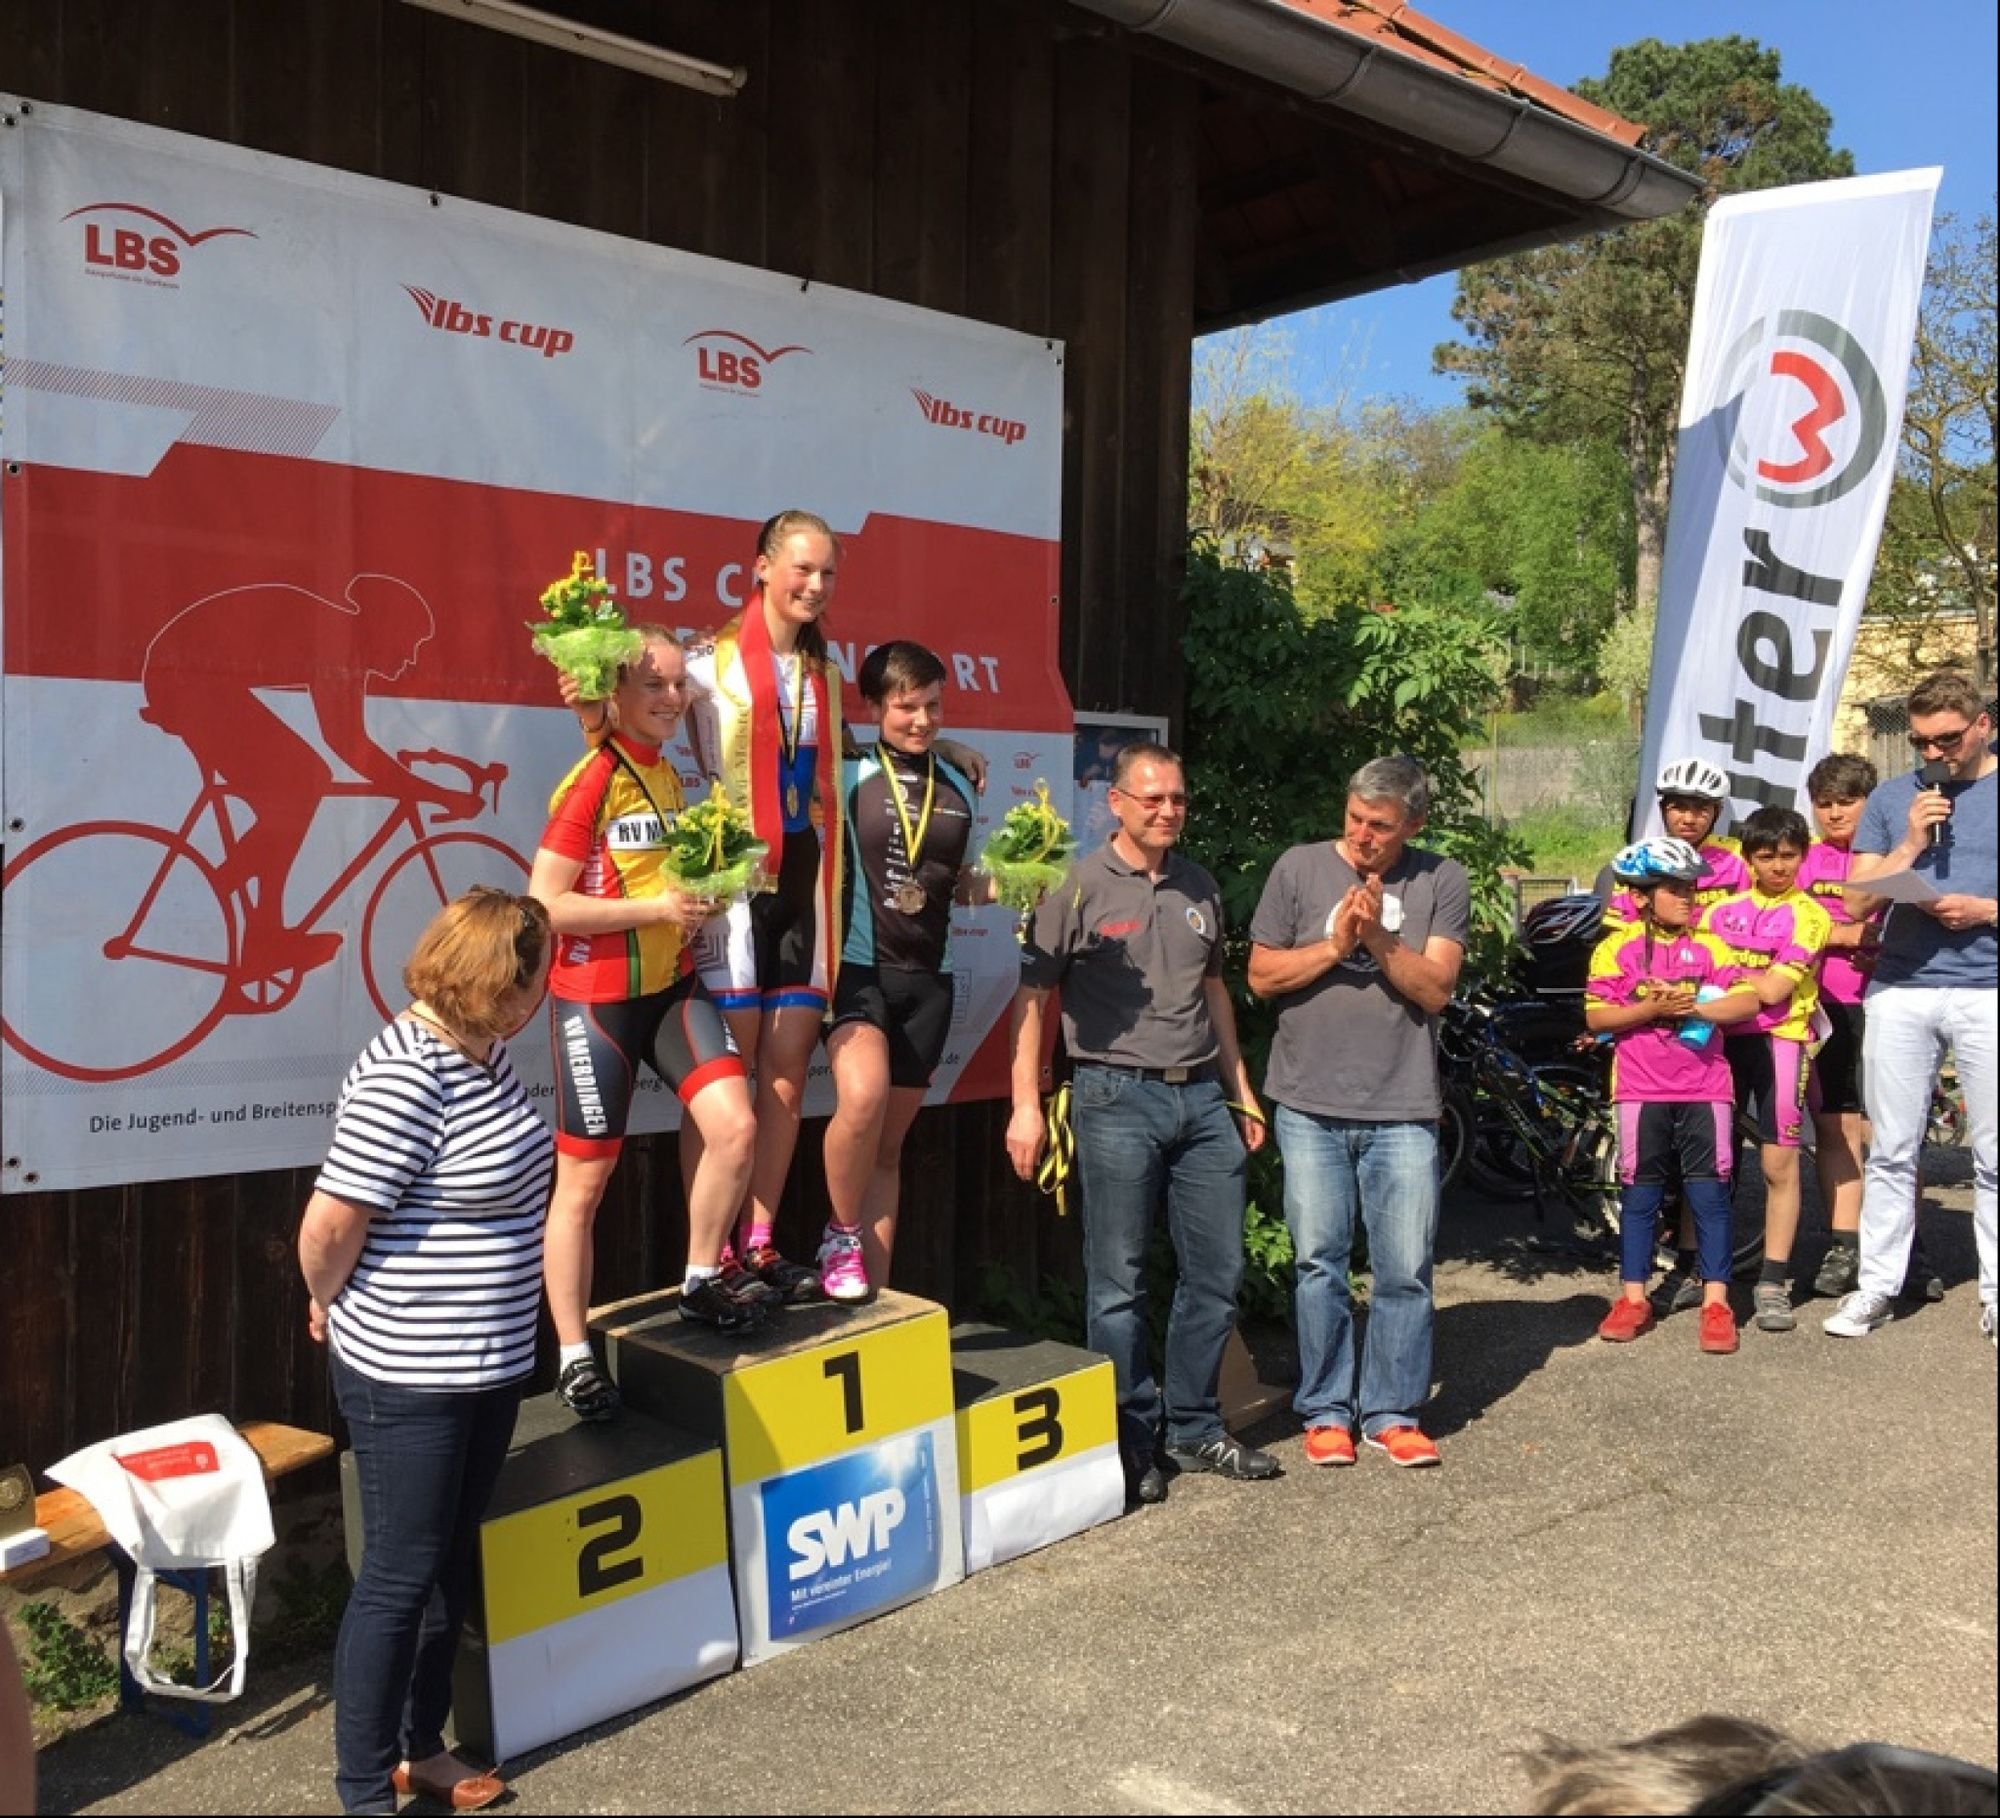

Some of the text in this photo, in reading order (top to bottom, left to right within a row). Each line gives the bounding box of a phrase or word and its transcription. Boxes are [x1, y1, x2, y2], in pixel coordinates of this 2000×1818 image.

[85, 224, 181, 275] LBS
[432, 299, 574, 357] lbs cup
[699, 347, 761, 388] LBS
[931, 399, 1027, 445] lbs cup
[595, 548, 688, 602] LBS
[618, 824, 641, 843] RV
[566, 1036, 608, 1135] MERDINGEN
[90, 1115, 122, 1133] Die
[127, 1107, 205, 1133] Jugend-
[210, 1104, 247, 1124] und
[252, 1100, 337, 1120] Breitensp
[823, 1351, 867, 1435] 1
[1012, 1387, 1064, 1471] 3
[577, 1494, 645, 1598] 2
[786, 1487, 907, 1582] SWP
[791, 1586, 809, 1603] Mit
[810, 1572, 852, 1596] vereinter
